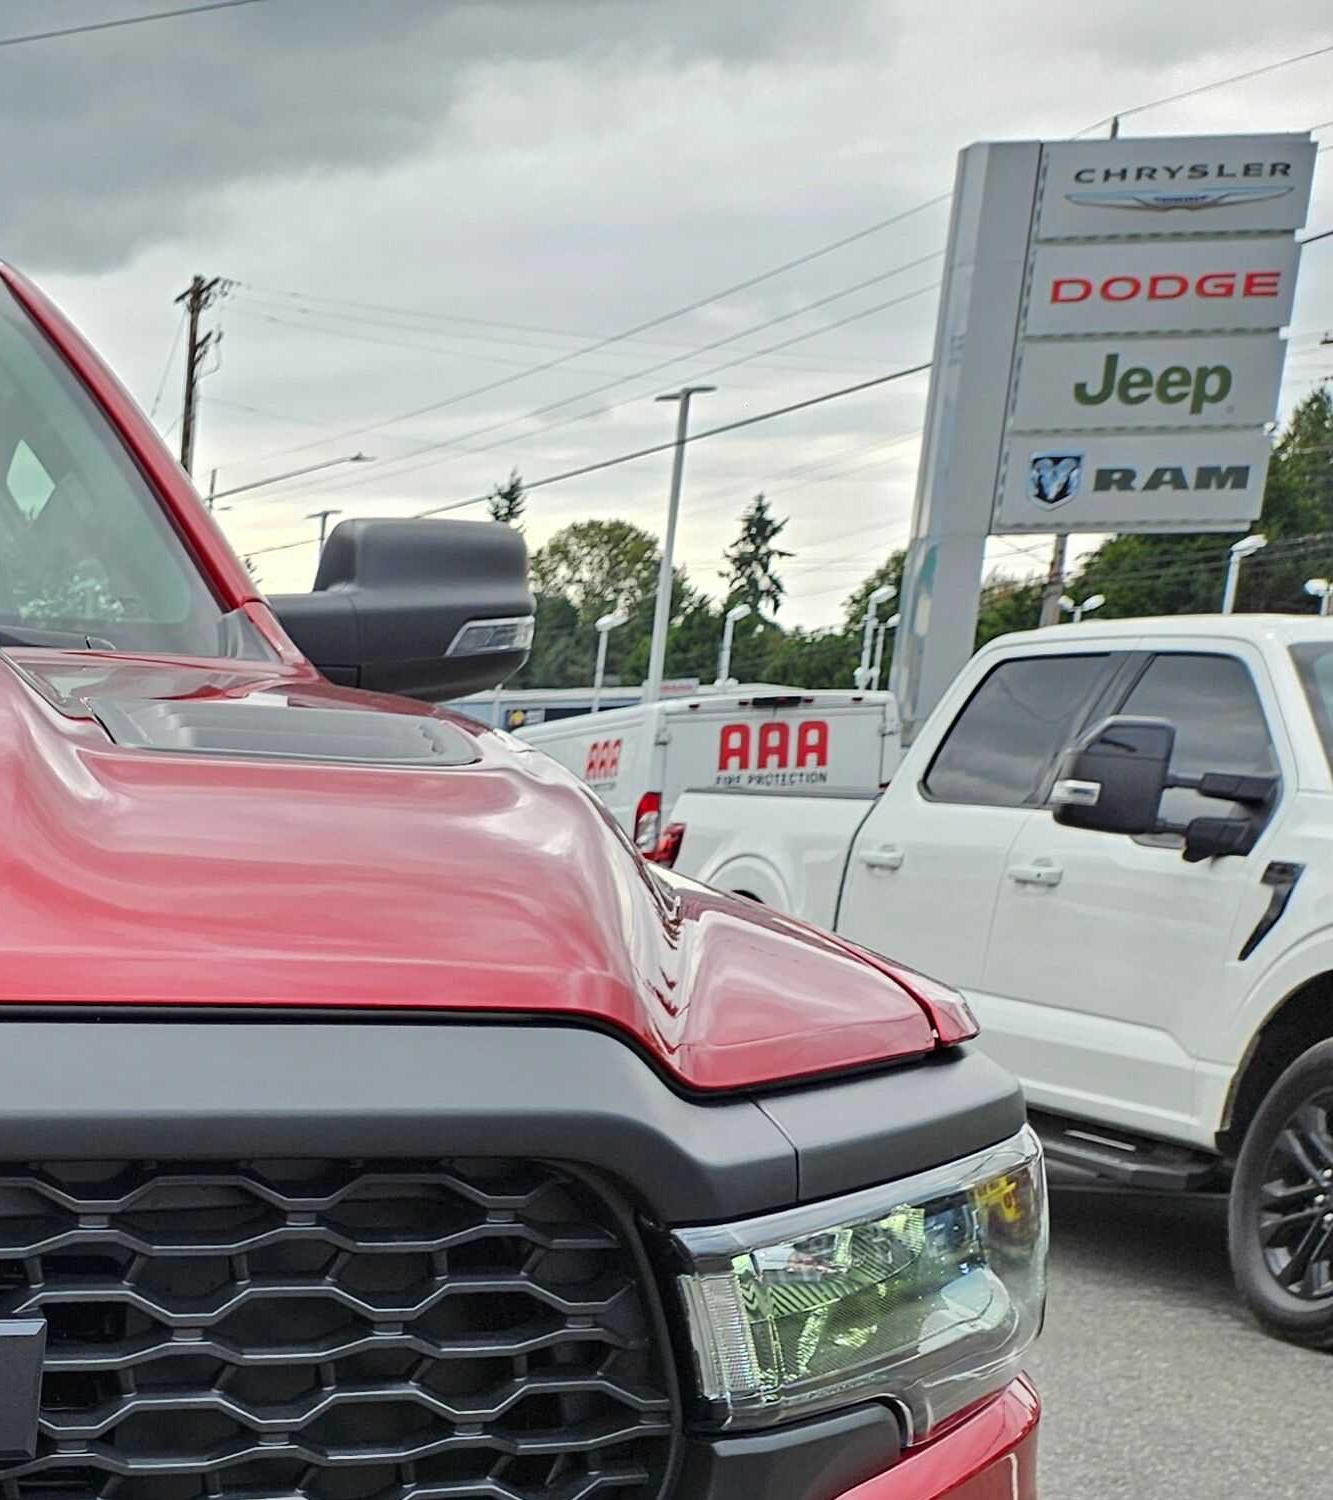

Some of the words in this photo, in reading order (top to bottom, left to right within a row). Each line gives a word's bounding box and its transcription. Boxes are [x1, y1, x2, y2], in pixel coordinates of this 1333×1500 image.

[1073, 161, 1293, 184] CHRYSLER
[1050, 271, 1282, 304] DODGE
[1073, 352, 1232, 415] Jeep
[1092, 464, 1251, 492] RAM
[718, 720, 829, 771] AAA
[747, 772, 828, 787] PROTECTION
